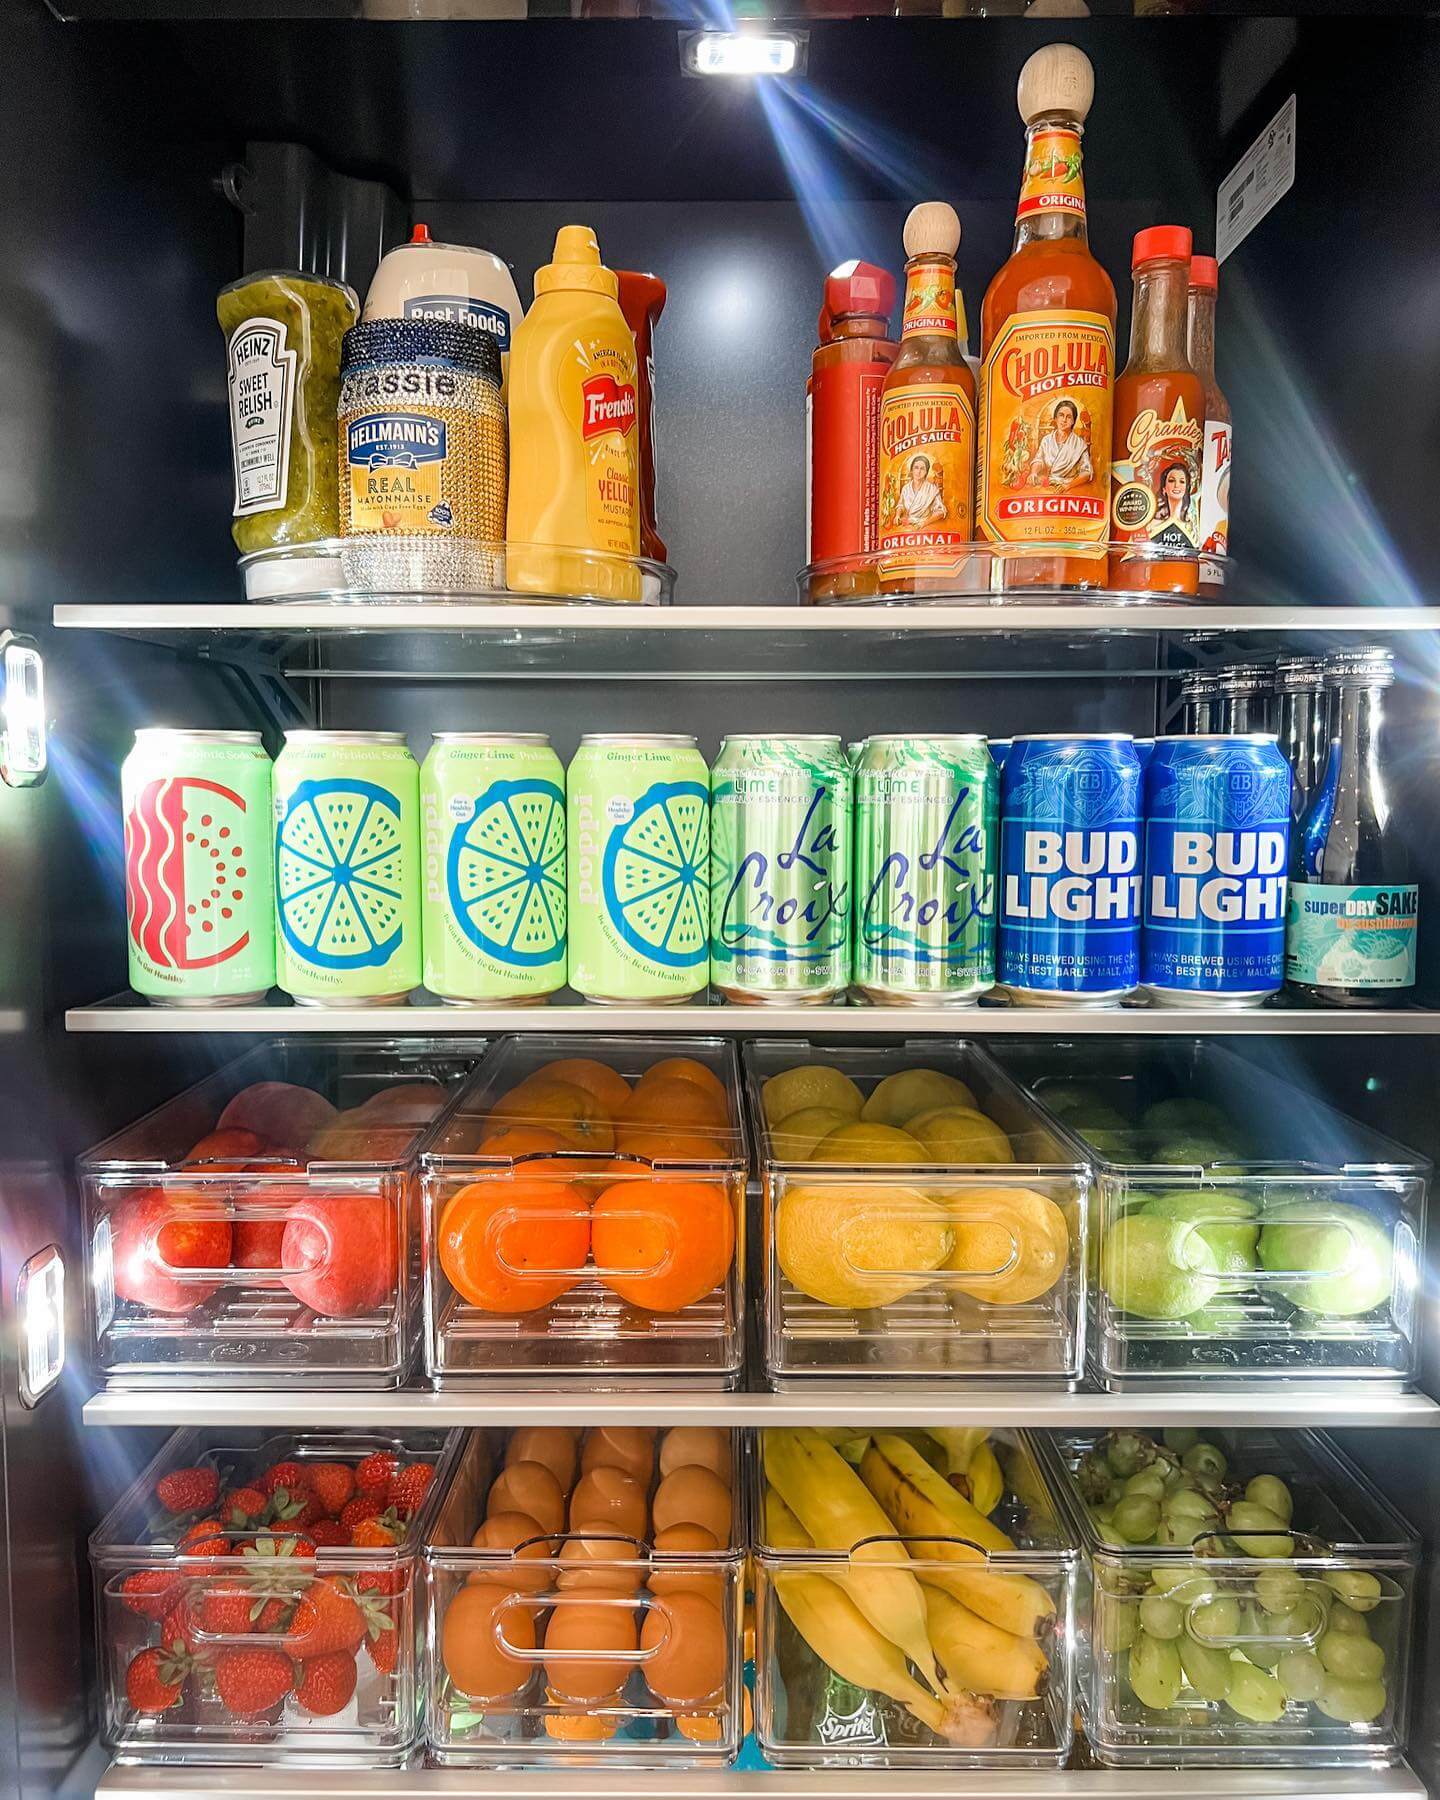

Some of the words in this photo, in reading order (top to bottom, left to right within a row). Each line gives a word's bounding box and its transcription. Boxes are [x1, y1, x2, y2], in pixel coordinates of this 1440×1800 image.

[458, 311, 506, 338] Foods
[903, 318, 948, 332] ORIGINAL
[1015, 332, 1056, 343] IMPORTED
[1057, 332, 1079, 341] FROM
[1080, 333, 1104, 344] MEXICO
[236, 337, 271, 366] HEINZ
[1001, 342, 1109, 398] CHOLULA
[239, 372, 269, 397] SWEET
[1030, 376, 1062, 397] HOT
[1067, 373, 1103, 387] SAUCE
[239, 391, 273, 419] RELISH
[586, 391, 635, 424] French's
[350, 421, 439, 451] HELLMANN'S
[882, 406, 961, 456] CHOLULA
[894, 439, 918, 456] HOT
[921, 431, 956, 444] SAUCE
[367, 477, 416, 494] REAL
[598, 479, 635, 509] YELLOW
[357, 494, 432, 504] MAYONNAISE
[1007, 499, 1100, 516] ORIGINAL
[1119, 504, 1146, 513] WINNING
[1163, 532, 1182, 542] HOT
[449, 750, 485, 761] Ginger
[487, 750, 516, 760] Lime
[606, 752, 643, 763] Ginger
[644, 752, 672, 762] Lime
[777, 786, 840, 877] La
[919, 786, 984, 877] La
[423, 792, 444, 903] poppi
[576, 793, 599, 905] poppi
[1024, 830, 1138, 875] BUD
[1172, 831, 1285, 876] BUD
[721, 851, 849, 945] Croix
[862, 851, 993, 945] Croix
[1005, 874, 1143, 921] LIGHT
[631, 958, 642, 968] Be
[642, 964, 656, 976] Gut
[658, 969, 688, 983] Healthy.
[1032, 953, 1075, 965] BREWED
[1076, 954, 1106, 965] USING
[1108, 954, 1123, 964] THE
[1180, 954, 1224, 966] BREWED
[1227, 956, 1255, 966] USING
[487, 964, 502, 976] Gut
[503, 968, 536, 982] Healthy.
[1028, 966, 1052, 977] BEST
[1055, 966, 1094, 978] BARLEY
[1176, 966, 1202, 977] BEST
[1204, 967, 1244, 978] BARLEY
[822, 1717, 873, 1740] Sprite
